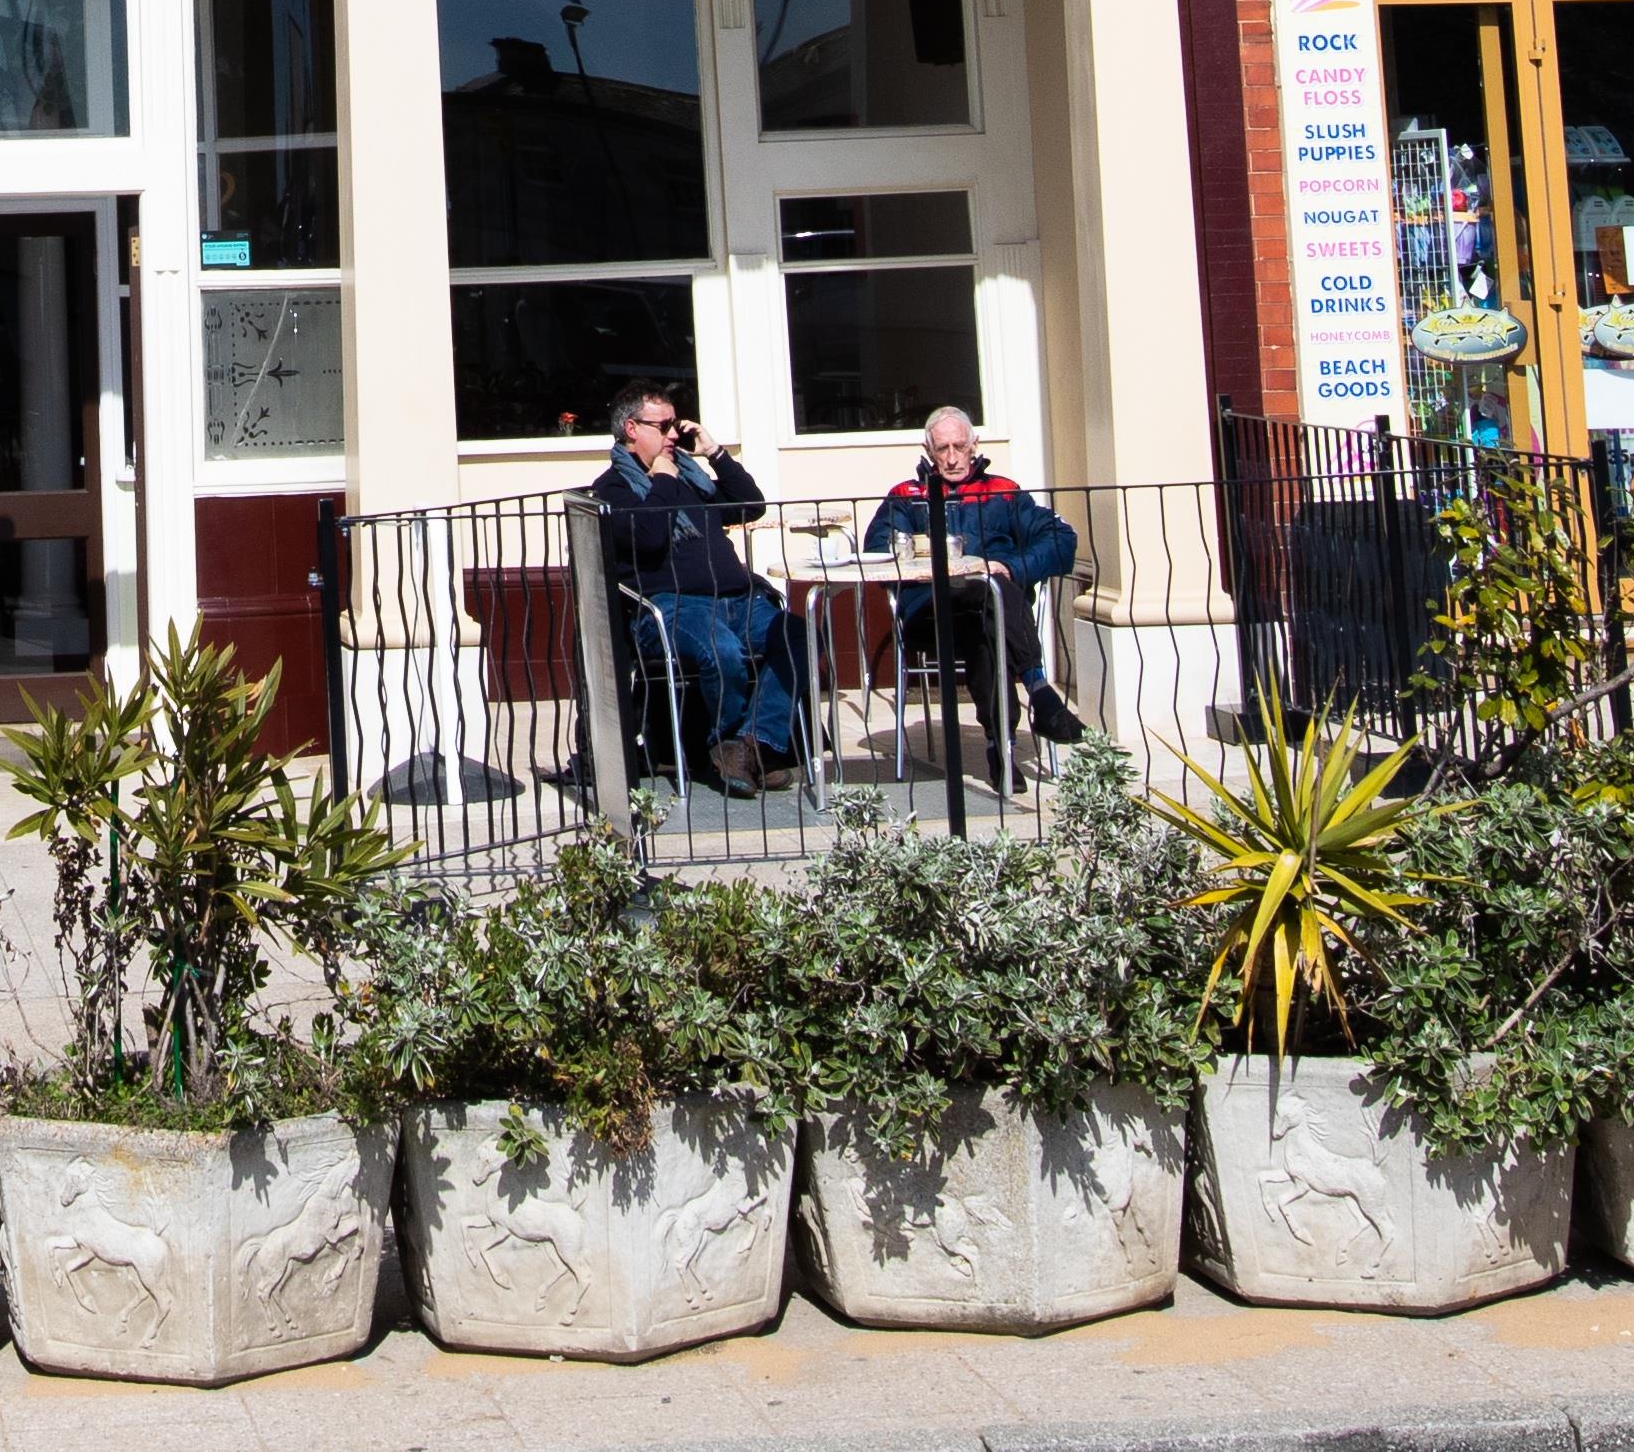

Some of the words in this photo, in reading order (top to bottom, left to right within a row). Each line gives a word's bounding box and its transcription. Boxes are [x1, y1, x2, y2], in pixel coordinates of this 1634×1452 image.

[1298, 33, 1358, 52] ROCK
[1295, 68, 1365, 85] CANDY
[1304, 90, 1362, 106] FLOSS
[1305, 124, 1366, 140] SLUSH
[1299, 145, 1376, 162] PUPPIES
[1299, 177, 1380, 193] POPCORN
[1304, 209, 1379, 225] NOUGAT
[1306, 241, 1383, 258] SWEETS
[1321, 276, 1373, 292] COLD
[1311, 297, 1387, 314] DRINKS
[1310, 330, 1391, 343] HONEYCOMB
[1319, 359, 1387, 376] BEACH
[1318, 381, 1391, 398] GOODS
